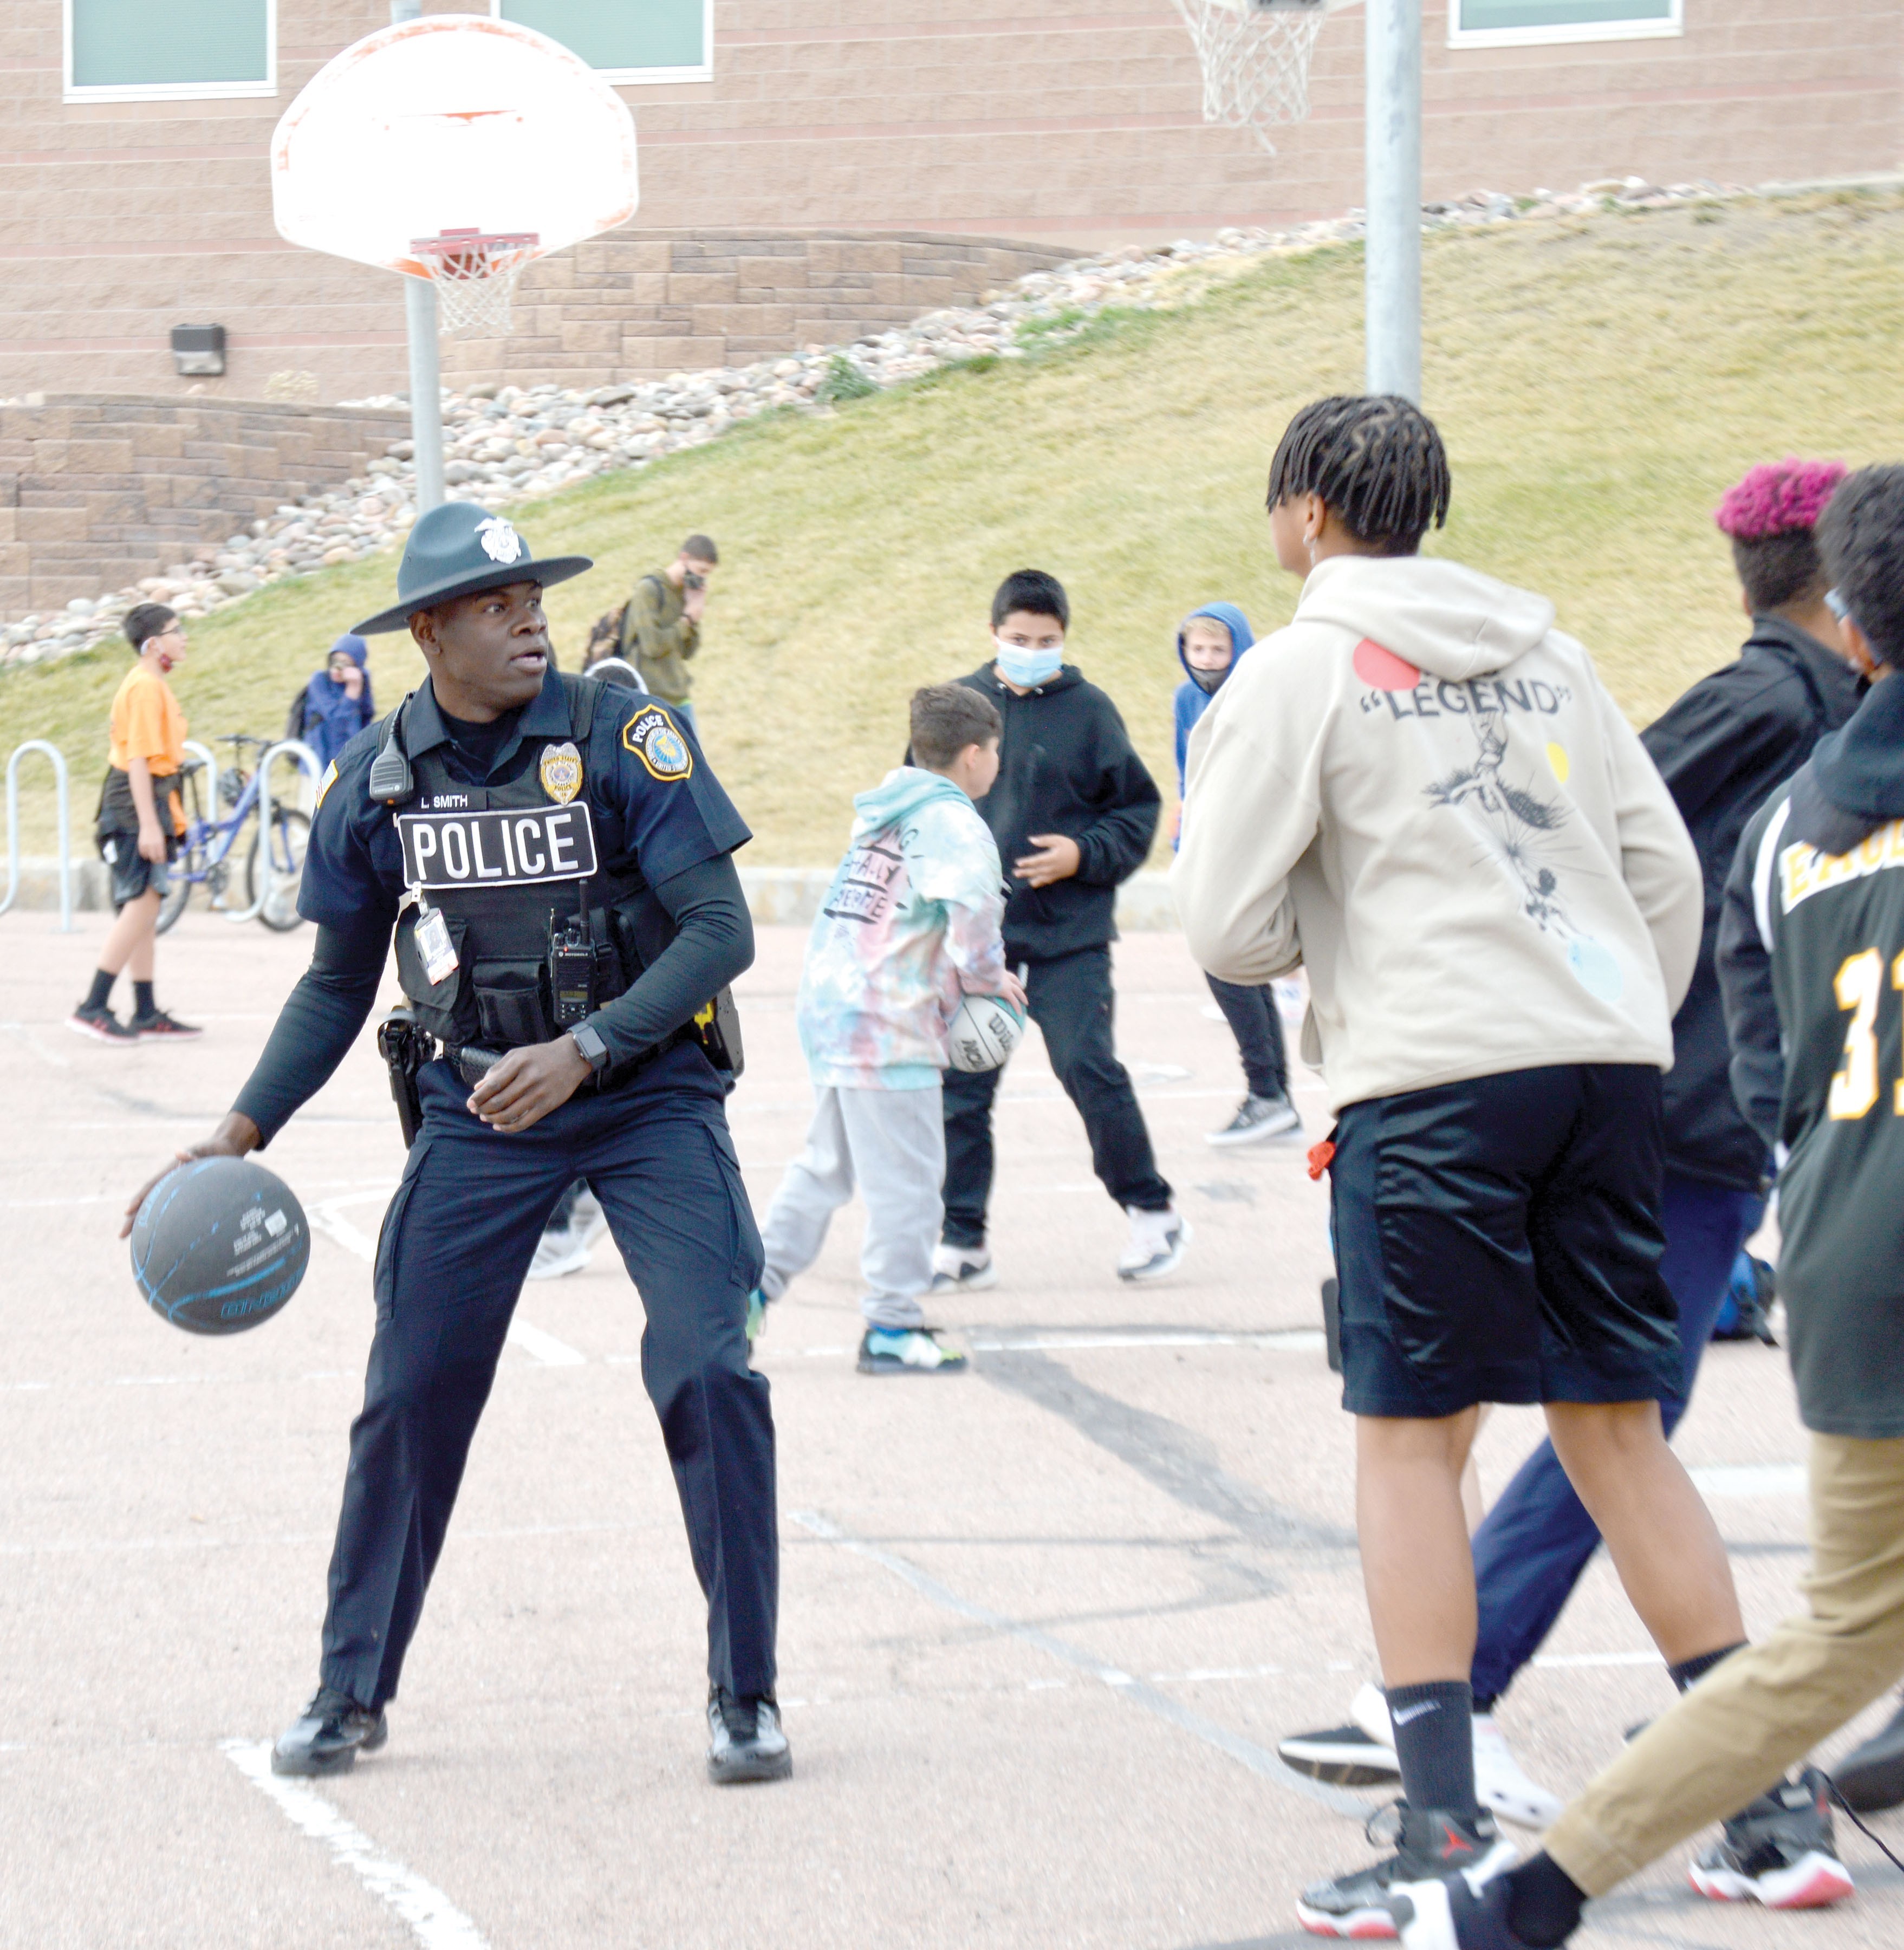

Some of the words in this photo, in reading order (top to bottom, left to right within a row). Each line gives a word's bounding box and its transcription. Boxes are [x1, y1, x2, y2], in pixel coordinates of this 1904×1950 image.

[632, 714, 664, 743] POLICE
[421, 797, 430, 809] L.
[433, 794, 468, 808] SMITH
[412, 814, 578, 880] POLICE
